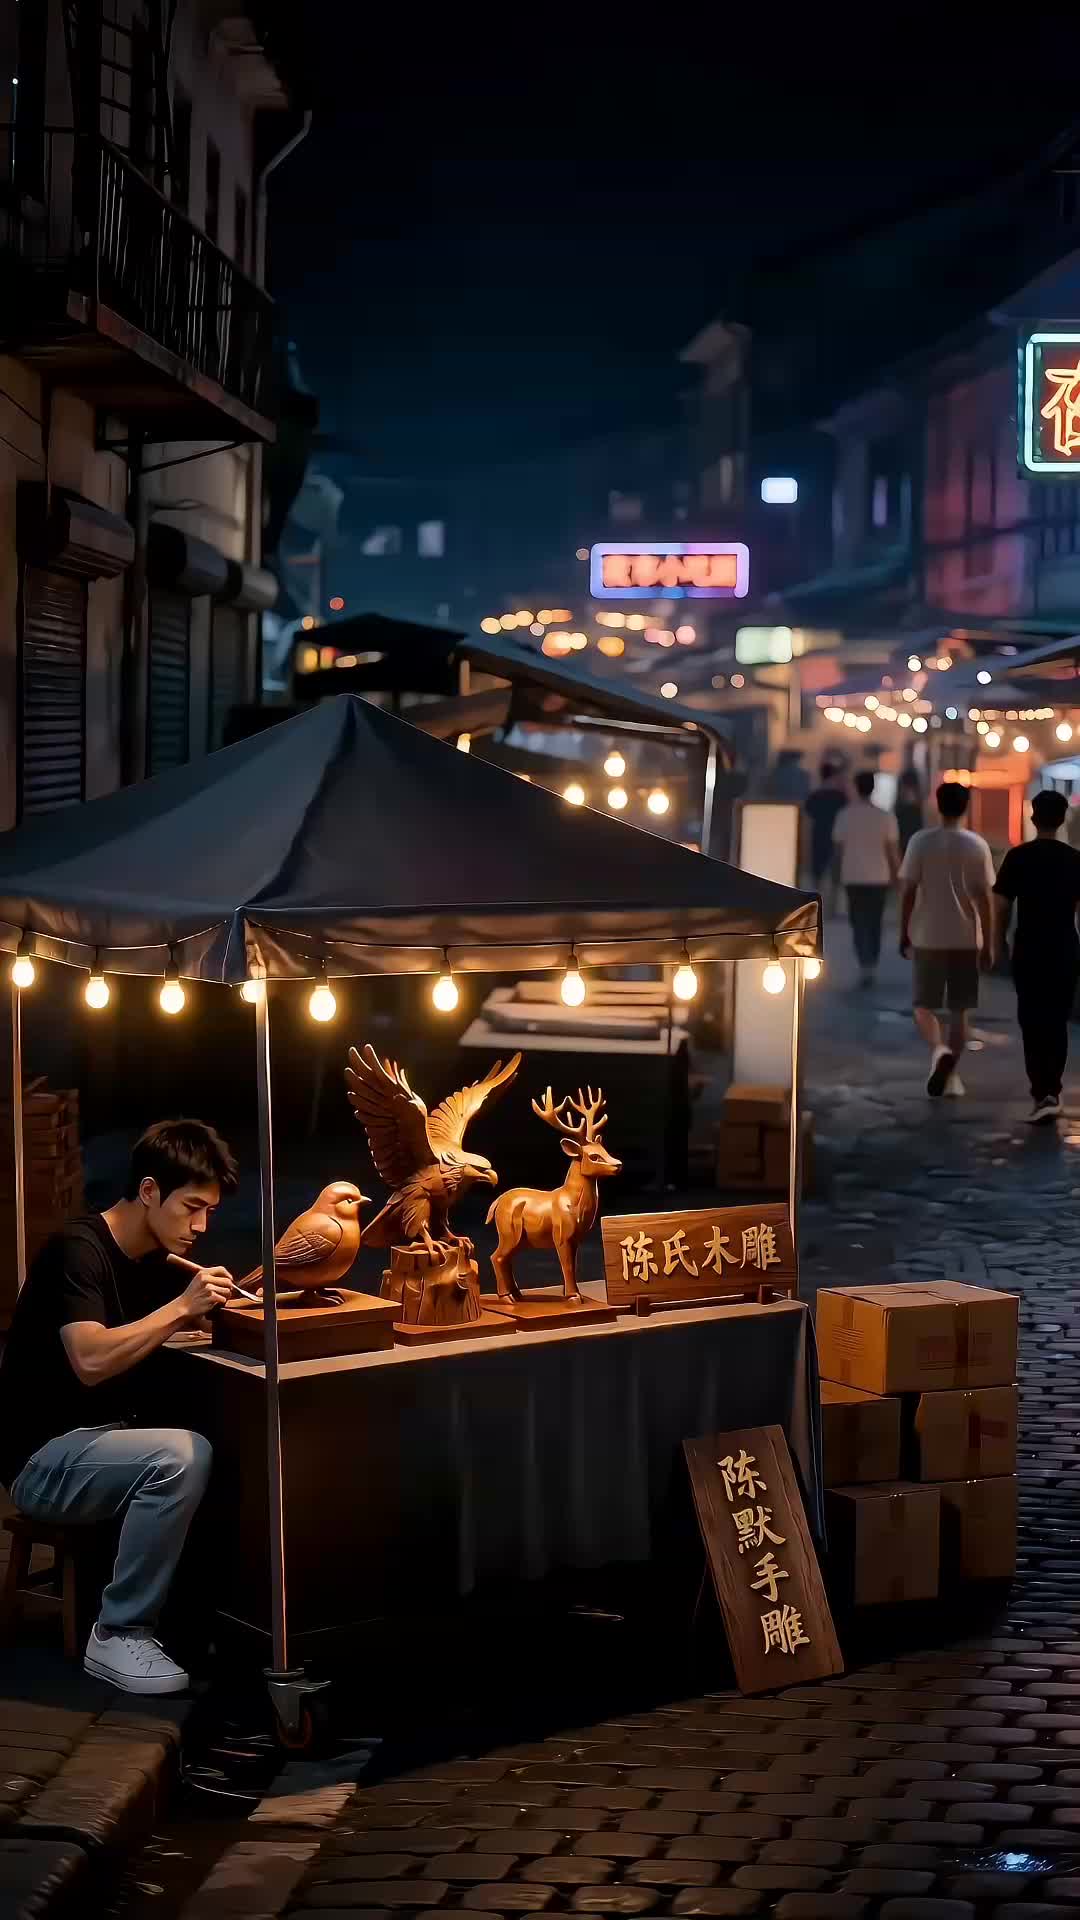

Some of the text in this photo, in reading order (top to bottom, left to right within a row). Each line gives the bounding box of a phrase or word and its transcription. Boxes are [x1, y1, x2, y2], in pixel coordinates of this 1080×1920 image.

[619, 1223, 782, 1282] 陈氏木雕
[717, 1449, 810, 1655] 陈默手雕
